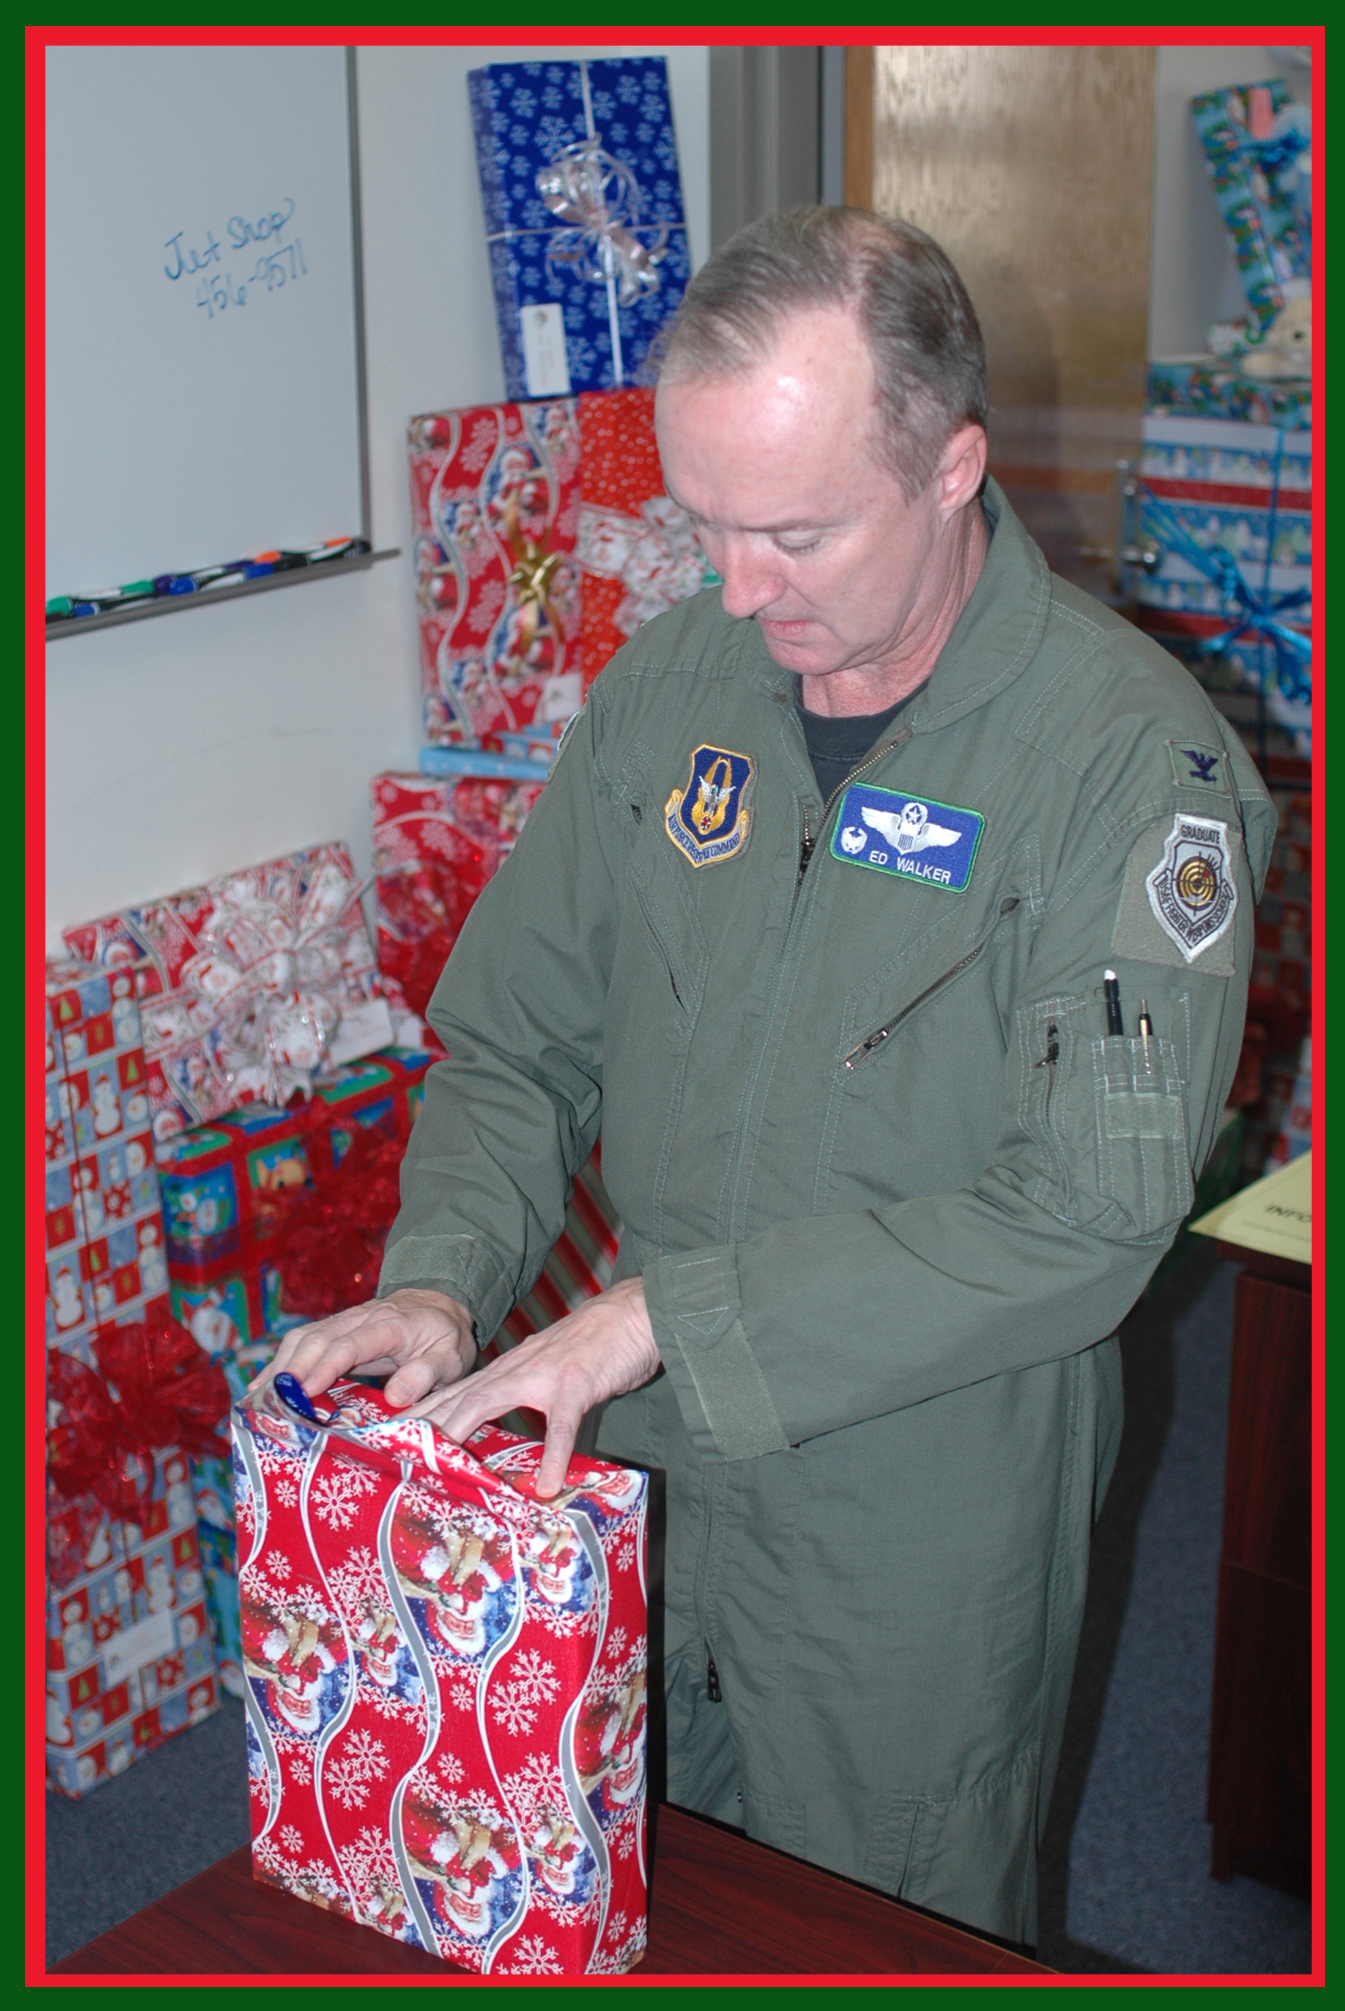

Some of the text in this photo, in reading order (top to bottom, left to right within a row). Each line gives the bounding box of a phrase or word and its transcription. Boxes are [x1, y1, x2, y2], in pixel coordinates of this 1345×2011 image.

[1180, 824, 1221, 845] GRADUATE
[869, 851, 951, 884] ED WALKER
